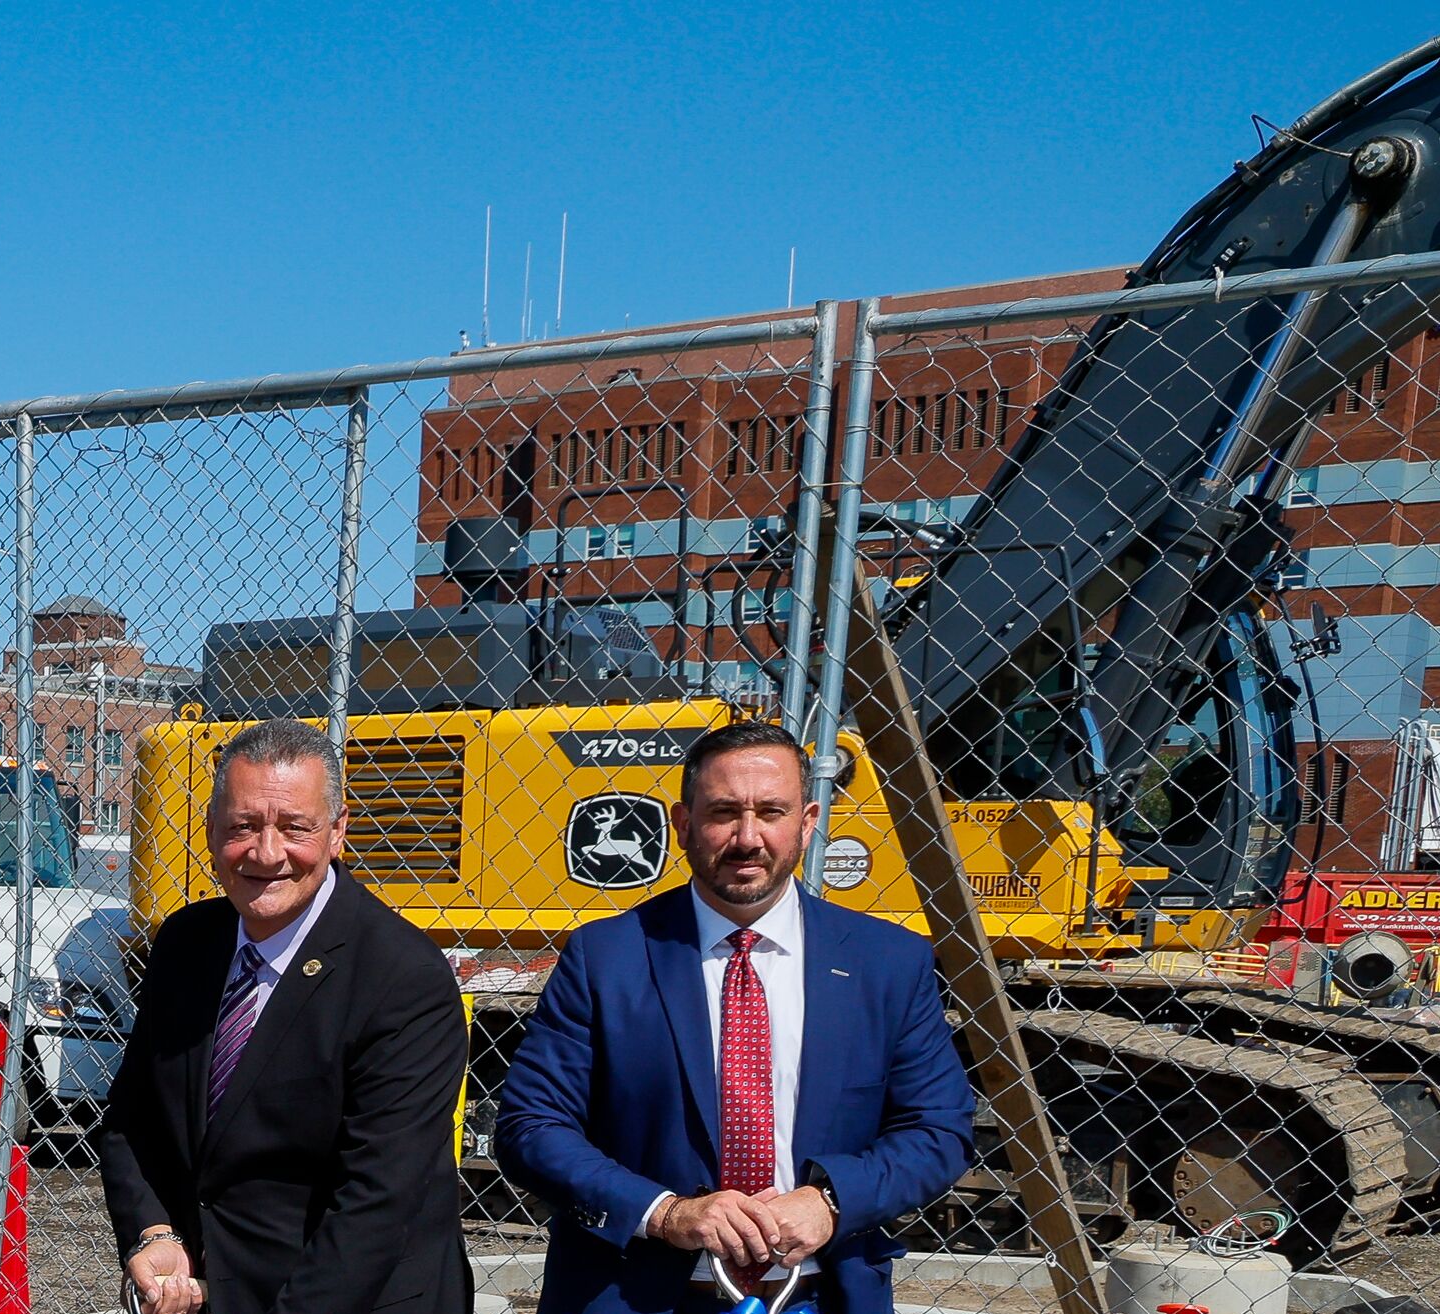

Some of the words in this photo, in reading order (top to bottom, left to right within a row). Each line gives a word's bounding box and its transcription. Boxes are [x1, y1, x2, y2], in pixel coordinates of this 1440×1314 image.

[582, 739, 656, 758] 470G
[823, 860, 868, 869] JESCO
[1340, 890, 1440, 909] ADLER
